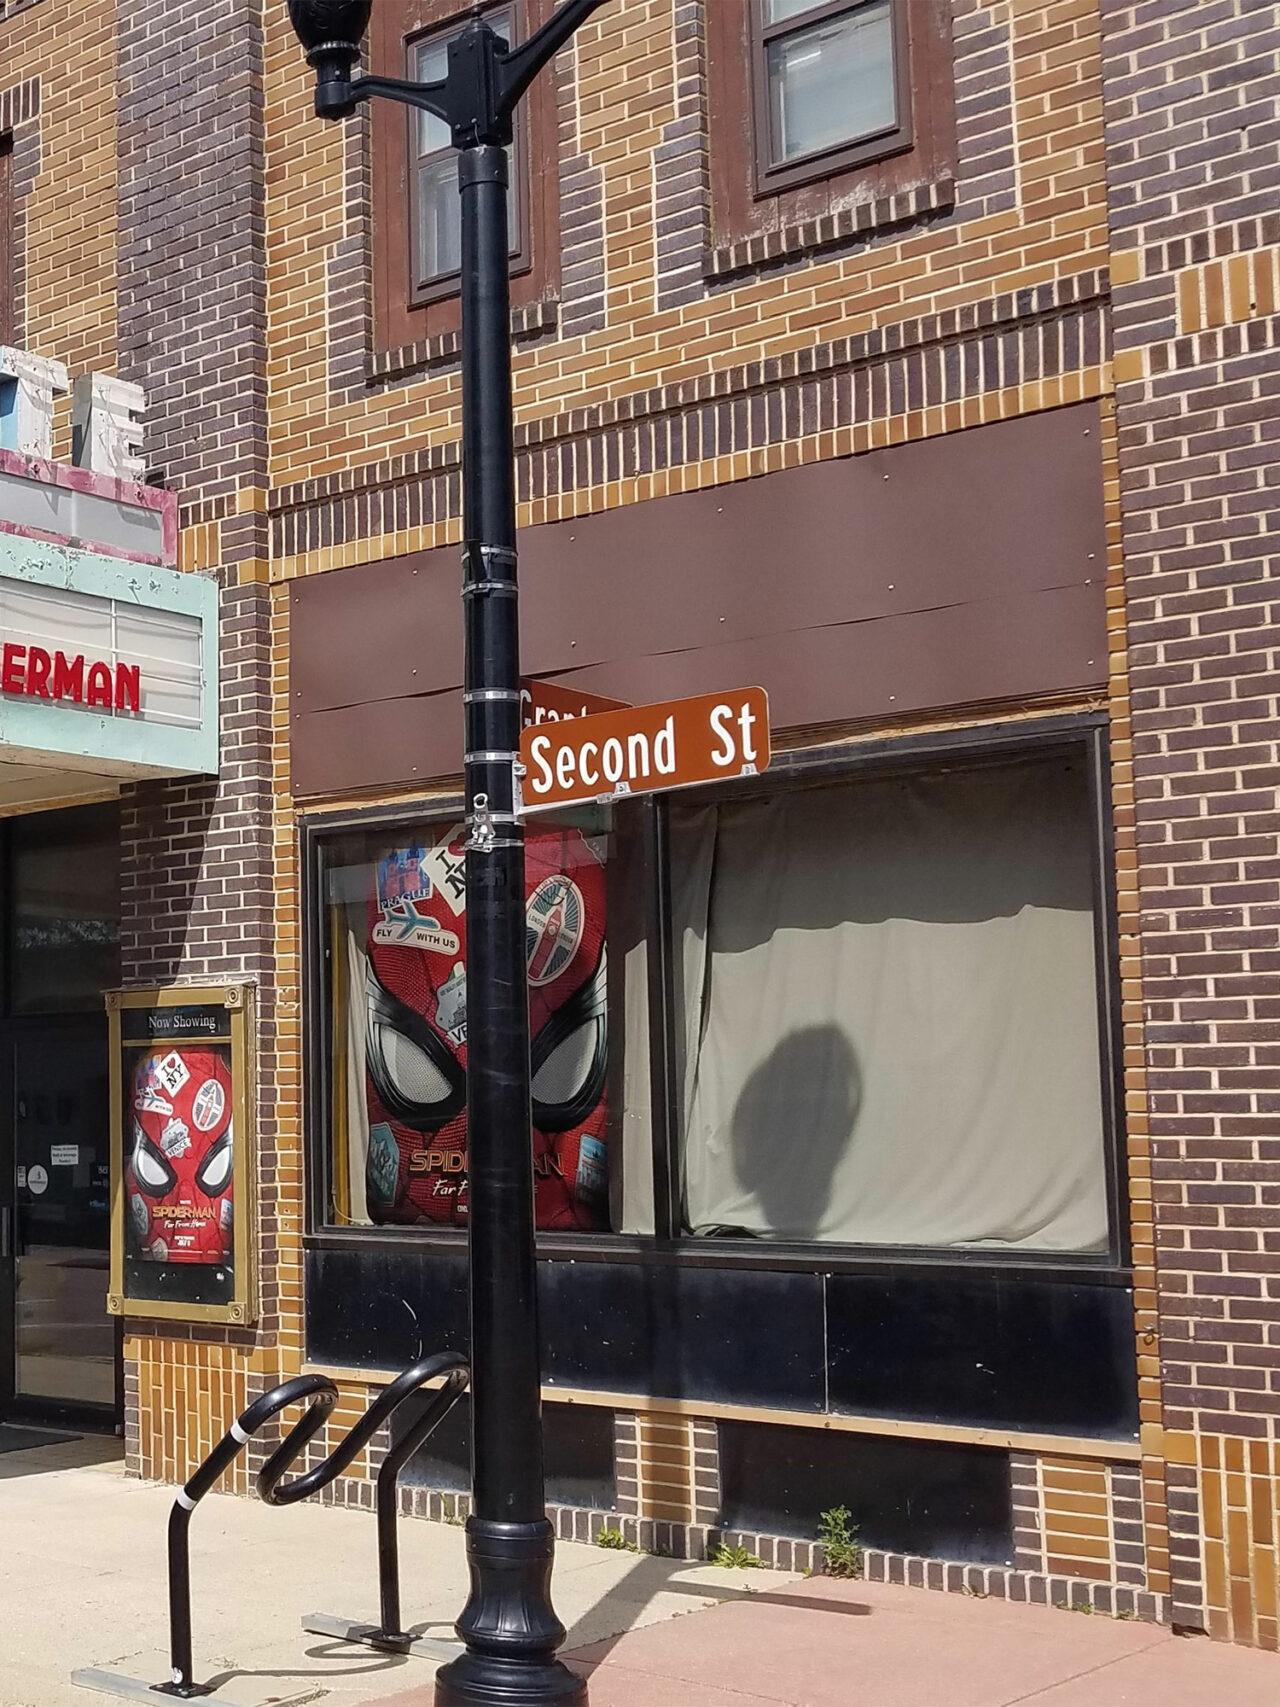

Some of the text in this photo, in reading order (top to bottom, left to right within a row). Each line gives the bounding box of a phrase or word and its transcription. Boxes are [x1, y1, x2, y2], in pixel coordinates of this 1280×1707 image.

[520, 688, 589, 729] Gra
[530, 702, 757, 794] Second St
[435, 849, 456, 875] I
[381, 888, 429, 910] PRAGUE
[376, 929, 456, 949] FLY WITH US
[148, 1013, 216, 1030] Now Showing
[161, 1066, 171, 1078] I
[166, 1063, 184, 1090] NY
[167, 1139, 188, 1157] VENICE
[432, 1178, 457, 1197] Far
[151, 1205, 217, 1219] SPIDER-MAN
